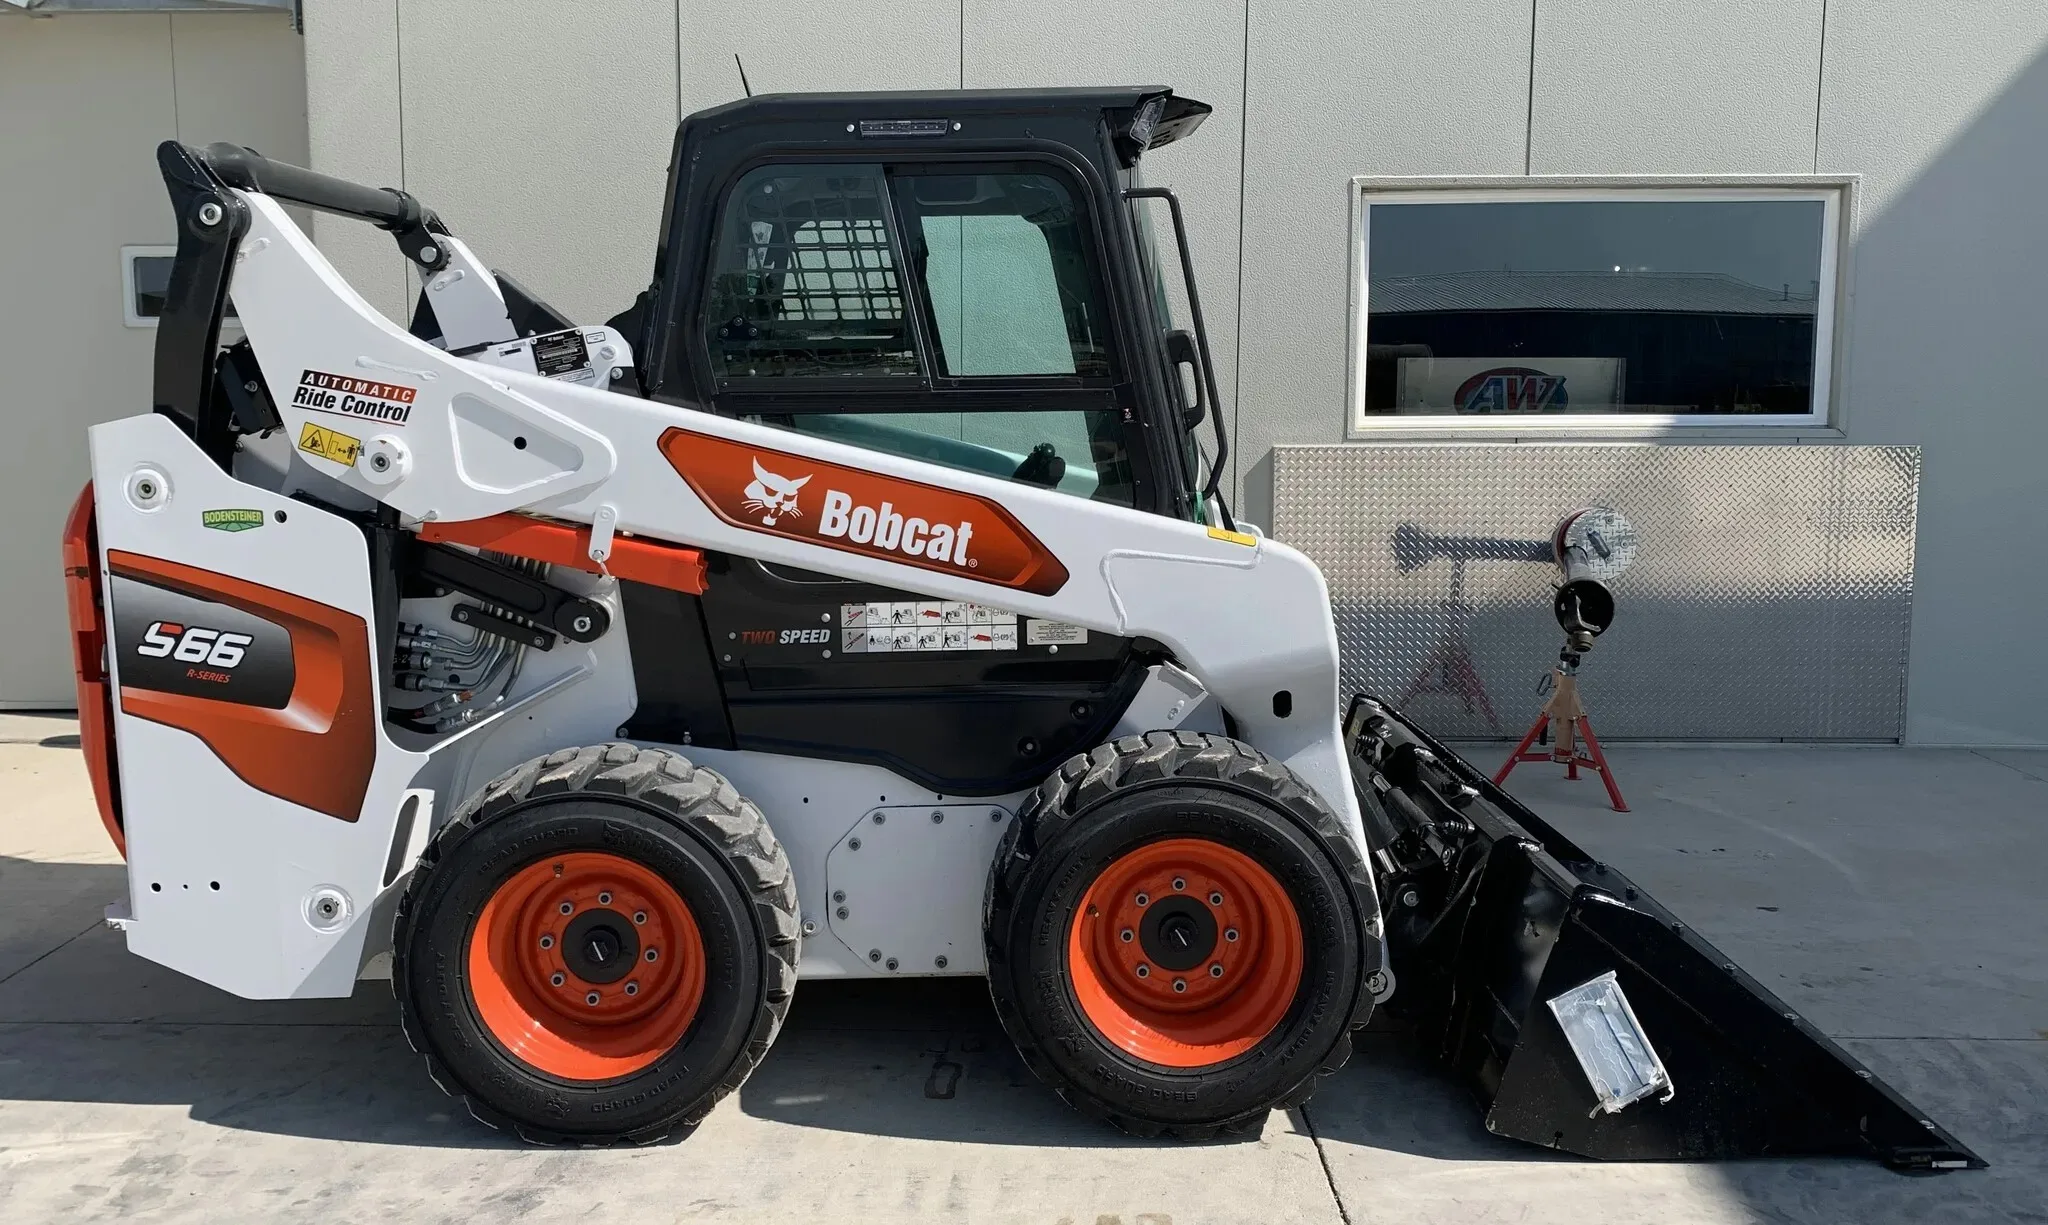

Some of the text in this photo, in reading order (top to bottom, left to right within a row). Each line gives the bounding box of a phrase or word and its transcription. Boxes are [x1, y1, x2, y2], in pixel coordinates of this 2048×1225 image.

[304, 373, 412, 402] AUTOMATIC
[293, 386, 412, 422] Ride Control
[203, 510, 262, 523] BODENSTEINER
[137, 621, 253, 668] S66
[742, 629, 830, 645] TWO SPEED
[186, 668, 231, 684] R-SERIES
